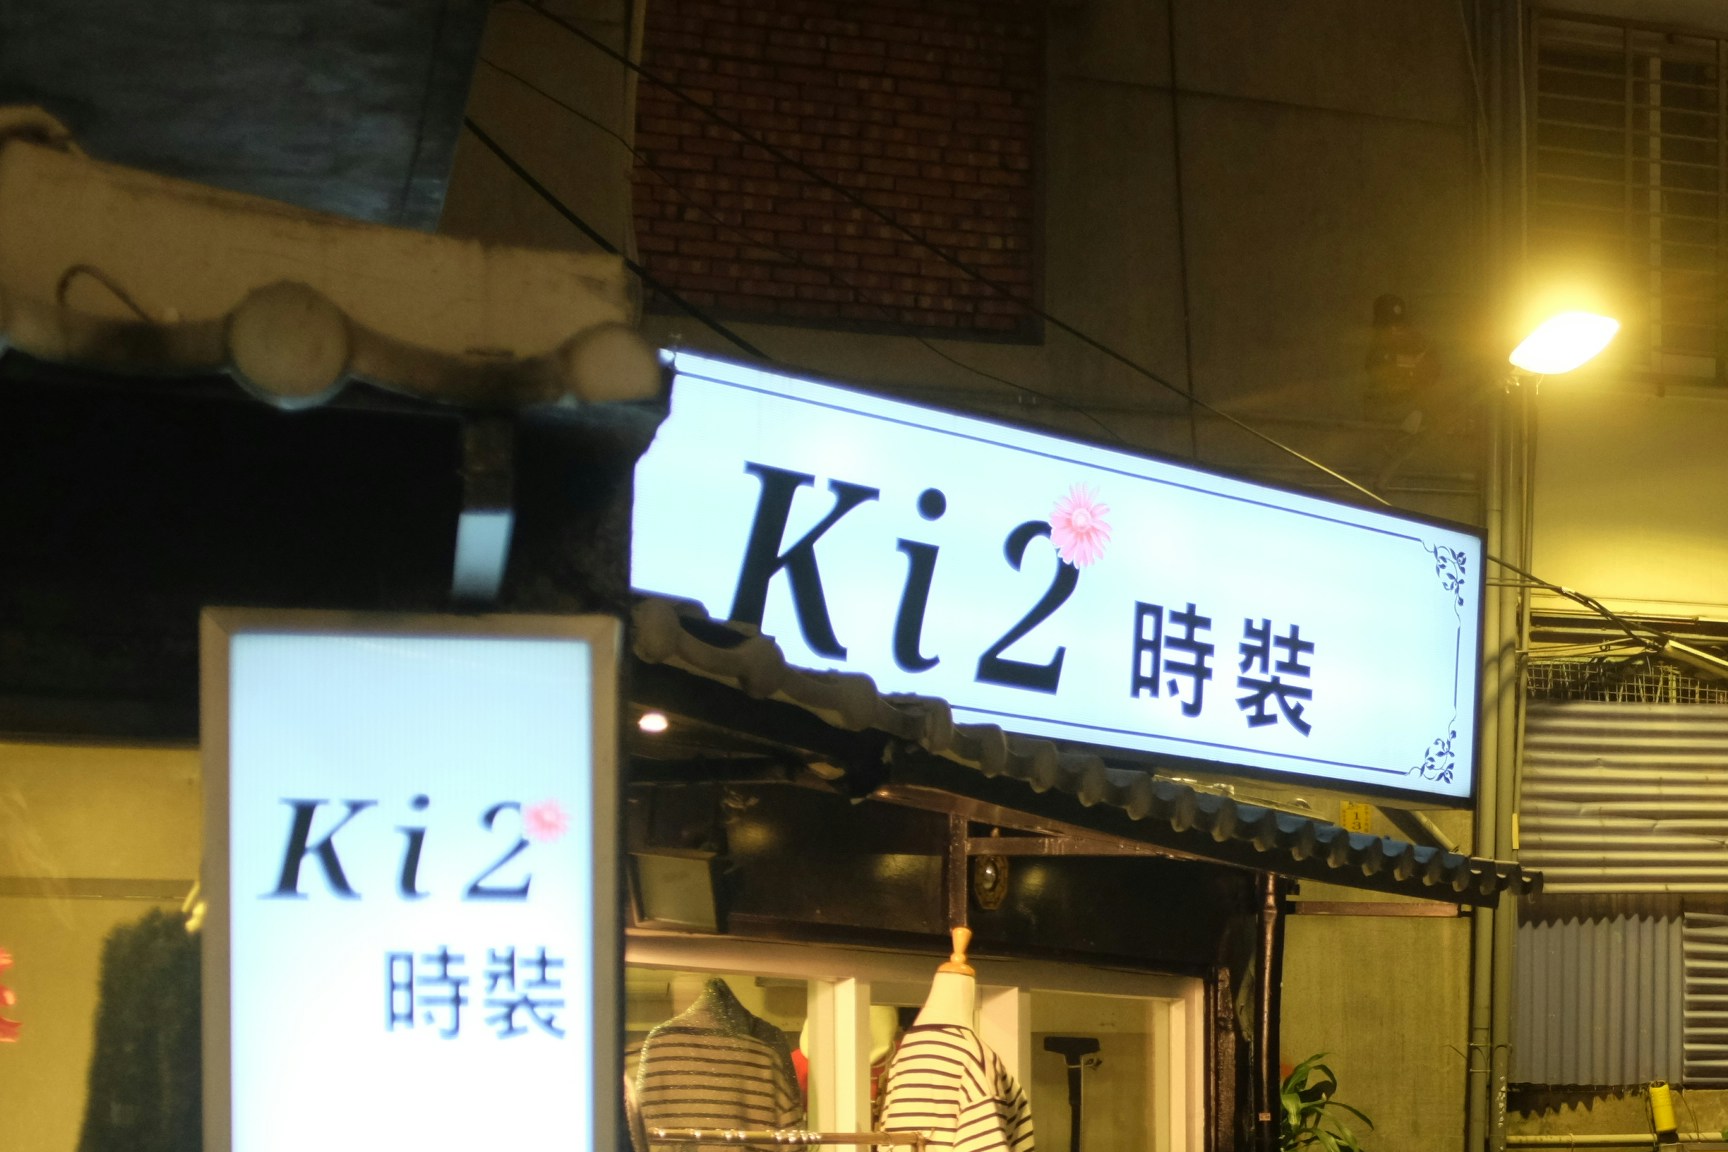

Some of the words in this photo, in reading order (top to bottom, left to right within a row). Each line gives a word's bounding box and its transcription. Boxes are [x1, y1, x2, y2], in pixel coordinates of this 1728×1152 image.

[728, 459, 1081, 695] Ki2
[1130, 600, 1315, 737] 時裝
[256, 793, 533, 902] Ki2
[383, 944, 567, 1040] 時裝
